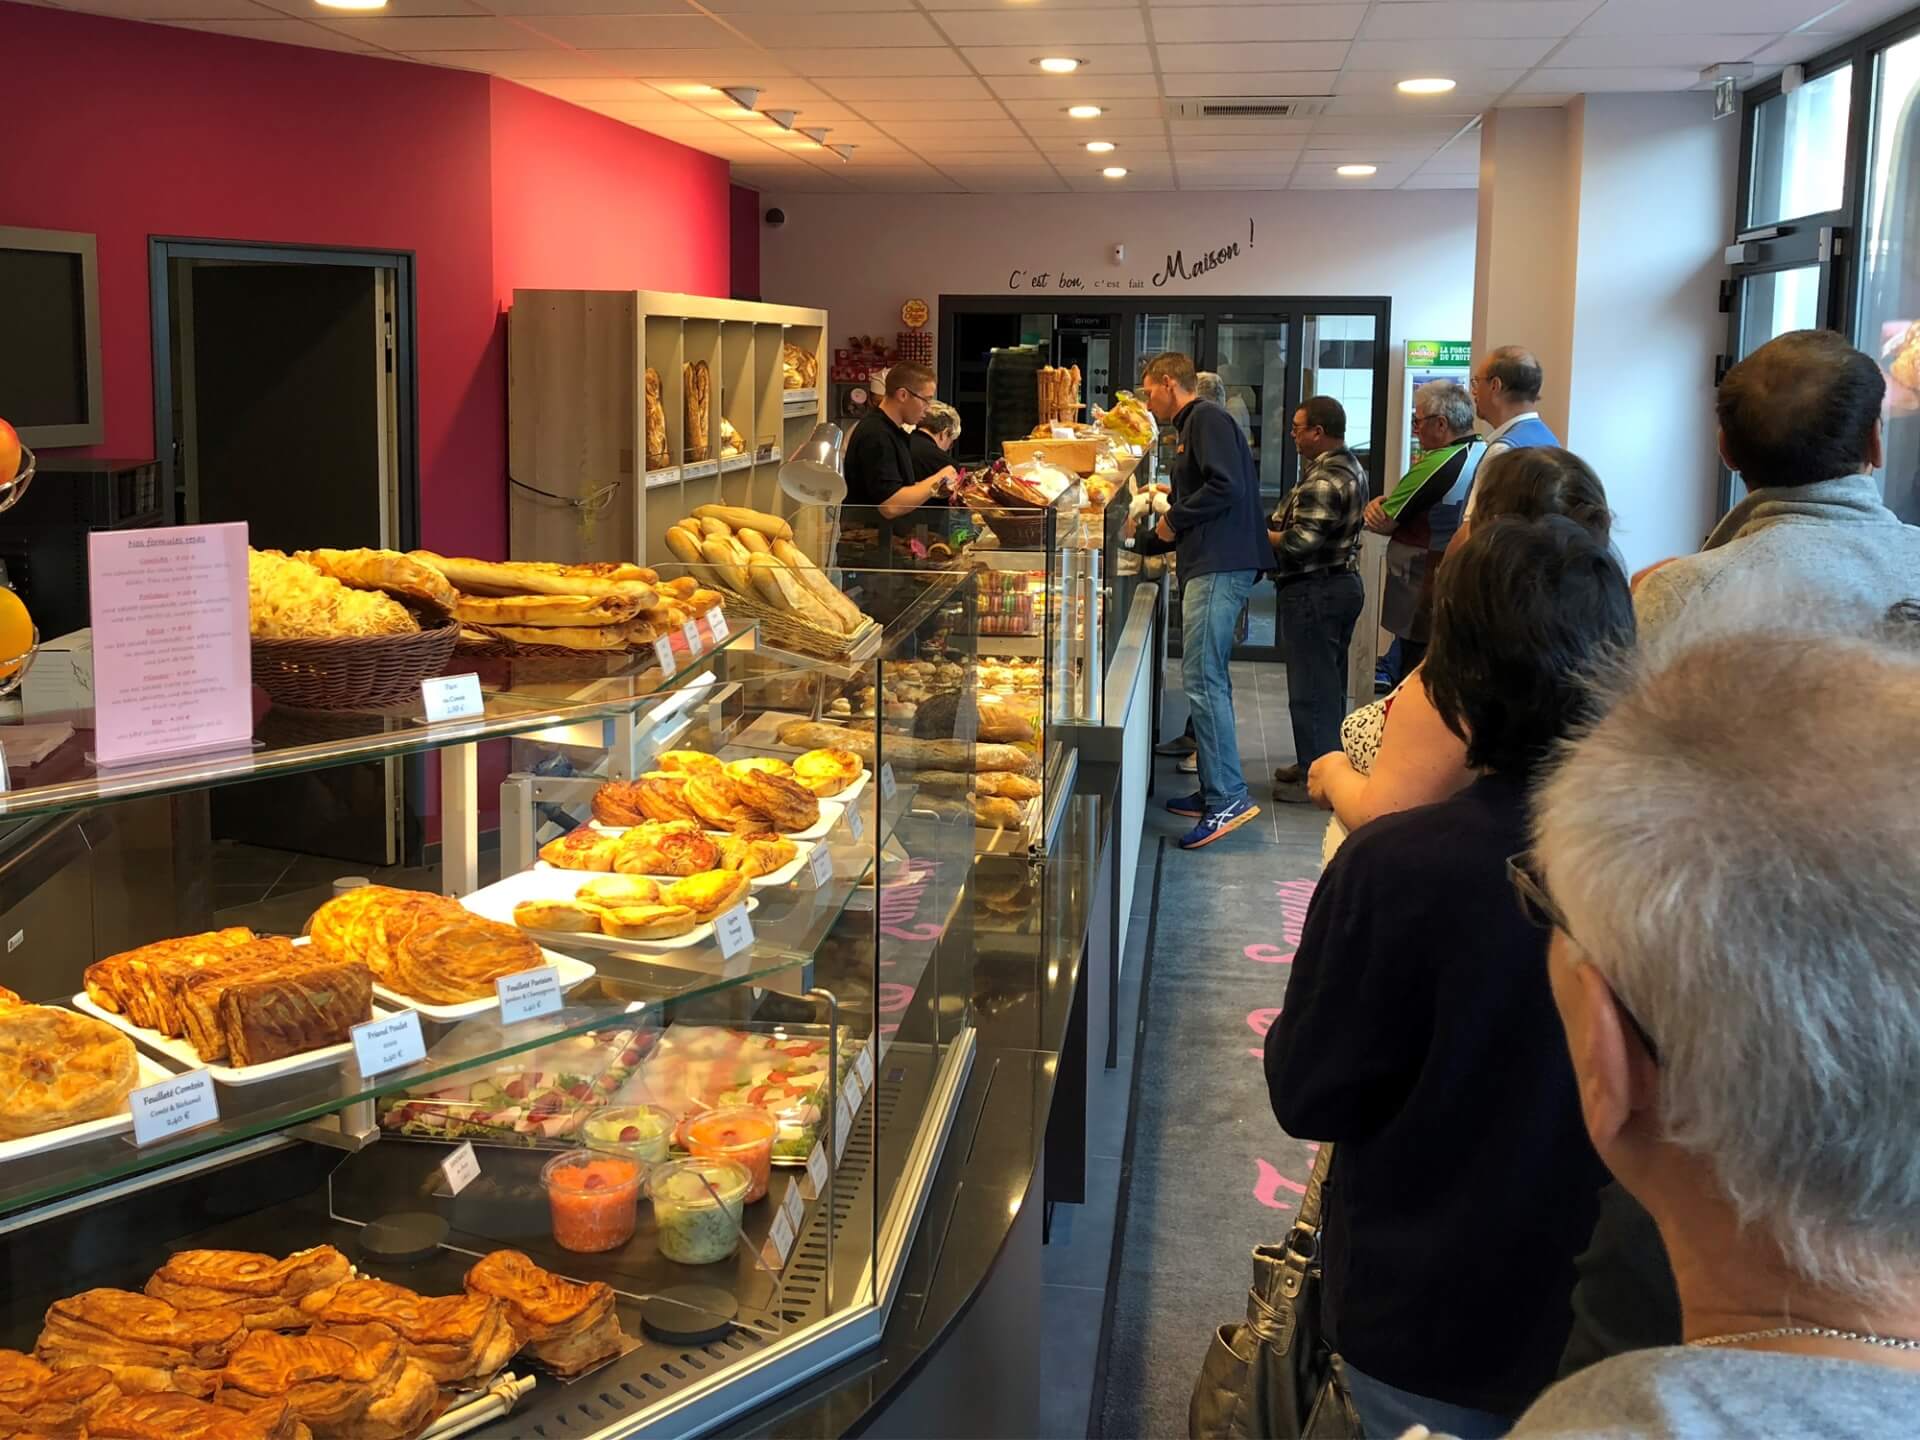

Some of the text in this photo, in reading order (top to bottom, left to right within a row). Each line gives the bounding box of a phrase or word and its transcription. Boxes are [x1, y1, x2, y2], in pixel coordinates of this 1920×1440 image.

[1009, 217, 1256, 290] C'est bon, c'est fait Maison !
[143, 1088, 174, 1106] Feuilleté
[184, 1111, 190, 1120] €
